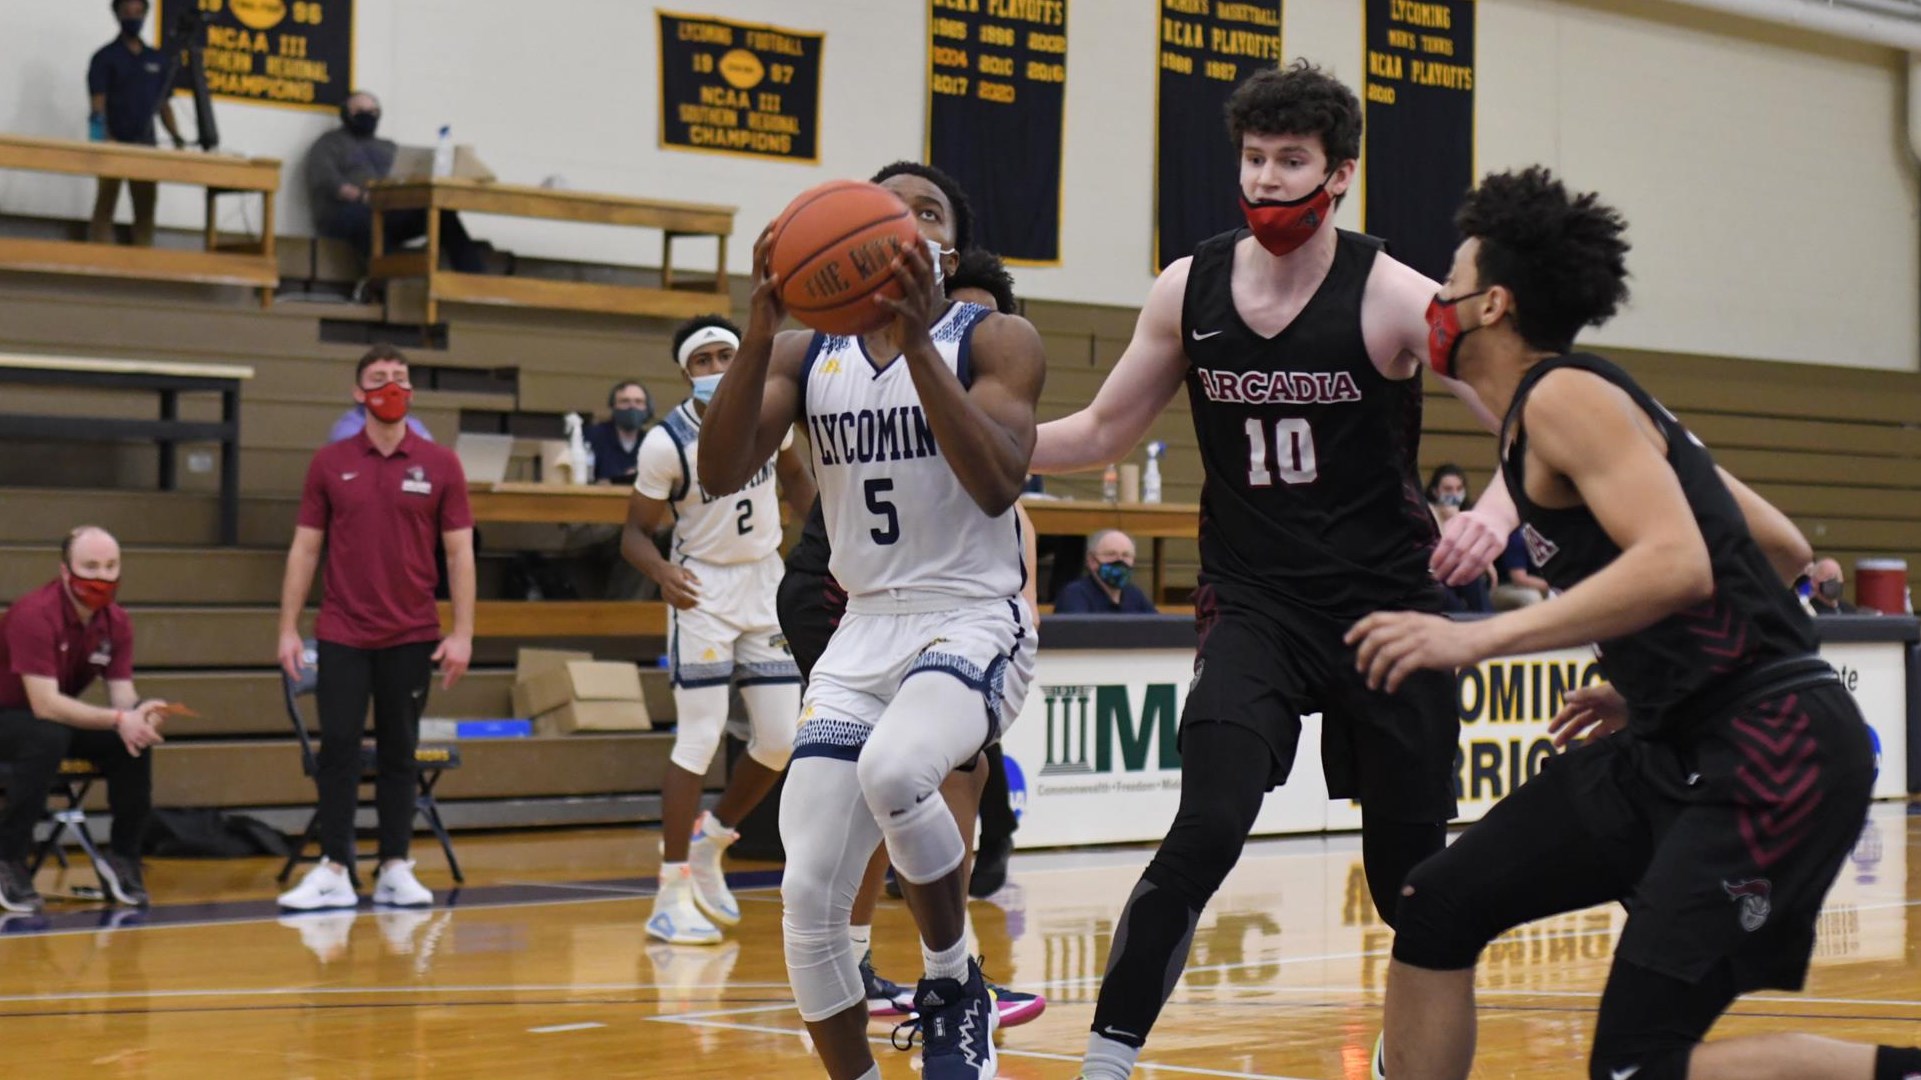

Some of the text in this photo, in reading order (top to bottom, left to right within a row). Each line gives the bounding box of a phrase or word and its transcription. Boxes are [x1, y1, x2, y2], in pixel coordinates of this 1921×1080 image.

[1390, 0, 1451, 29] LYCOMING
[207, 25, 307, 58] NCAA III
[1163, 17, 1280, 60] NCAA PLAYOFFS
[204, 70, 315, 102] HAMPIONS
[1369, 51, 1473, 90] NCAA PLAYOFFS
[701, 85, 781, 113] NCAA III
[689, 125, 792, 154] CHAMPIONS
[1198, 368, 1362, 405] ARCADIA
[811, 405, 937, 466] LYCOMIN
[1244, 418, 1318, 487] 10
[736, 499, 754, 536] 2
[864, 478, 900, 546] 5
